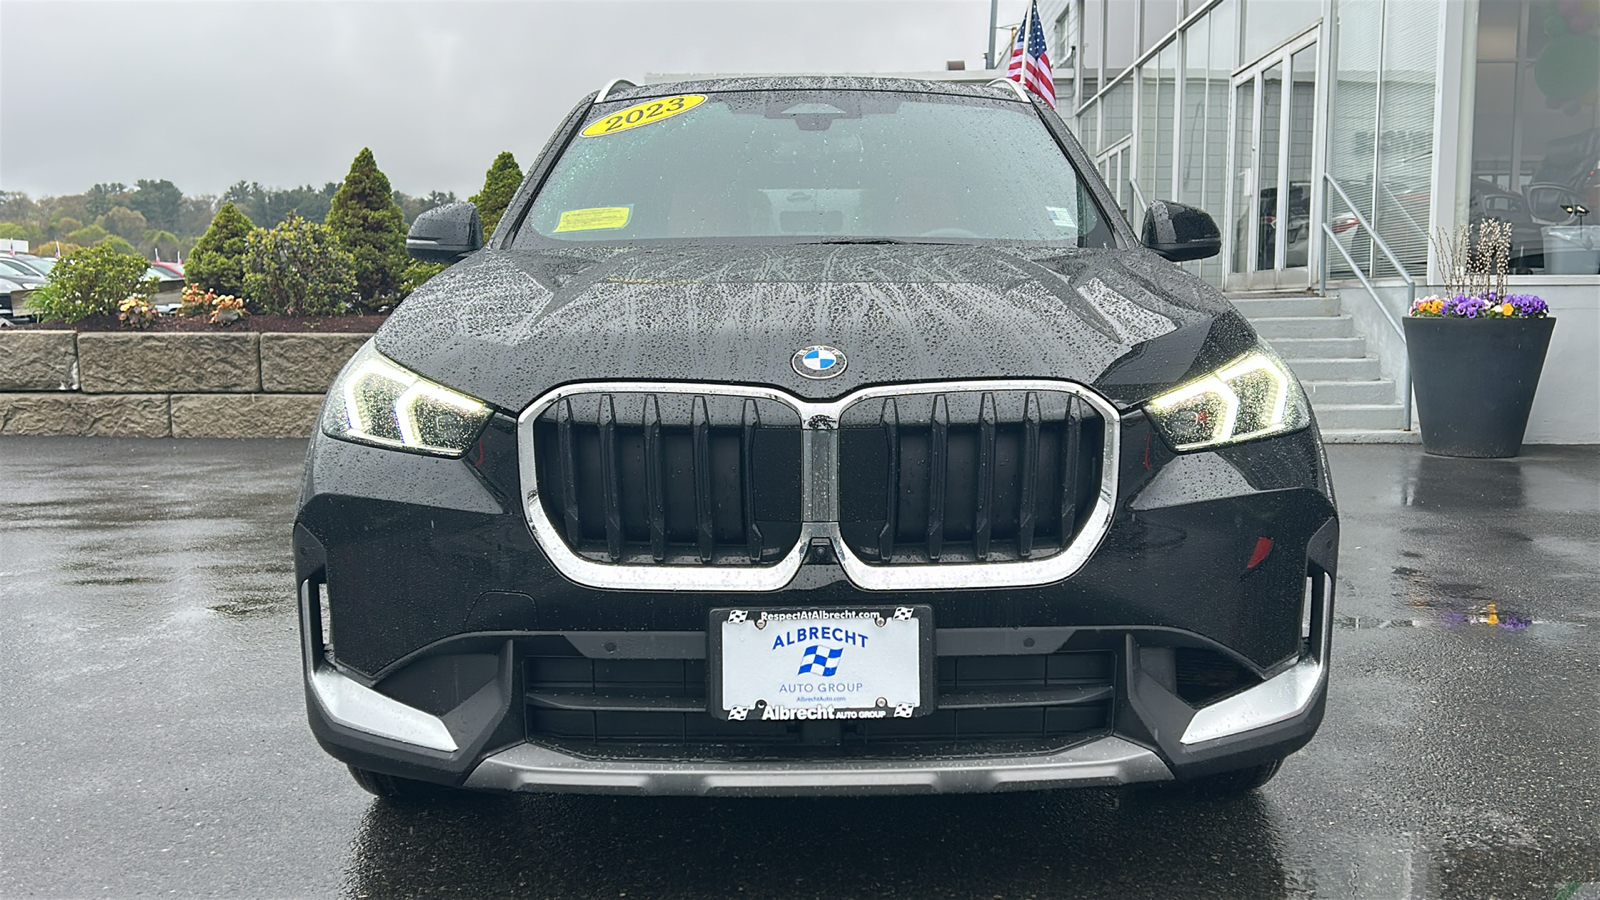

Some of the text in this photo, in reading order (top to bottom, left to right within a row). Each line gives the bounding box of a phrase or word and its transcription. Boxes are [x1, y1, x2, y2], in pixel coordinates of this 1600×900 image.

[605, 98, 684, 132] 2023
[761, 610, 880, 622] RespectAtAlbrecht.com
[772, 627, 868, 650] ALBRECHT
[779, 682, 863, 693] AUTO GROUP
[762, 704, 886, 720] Albrecht AUTO GROUP
